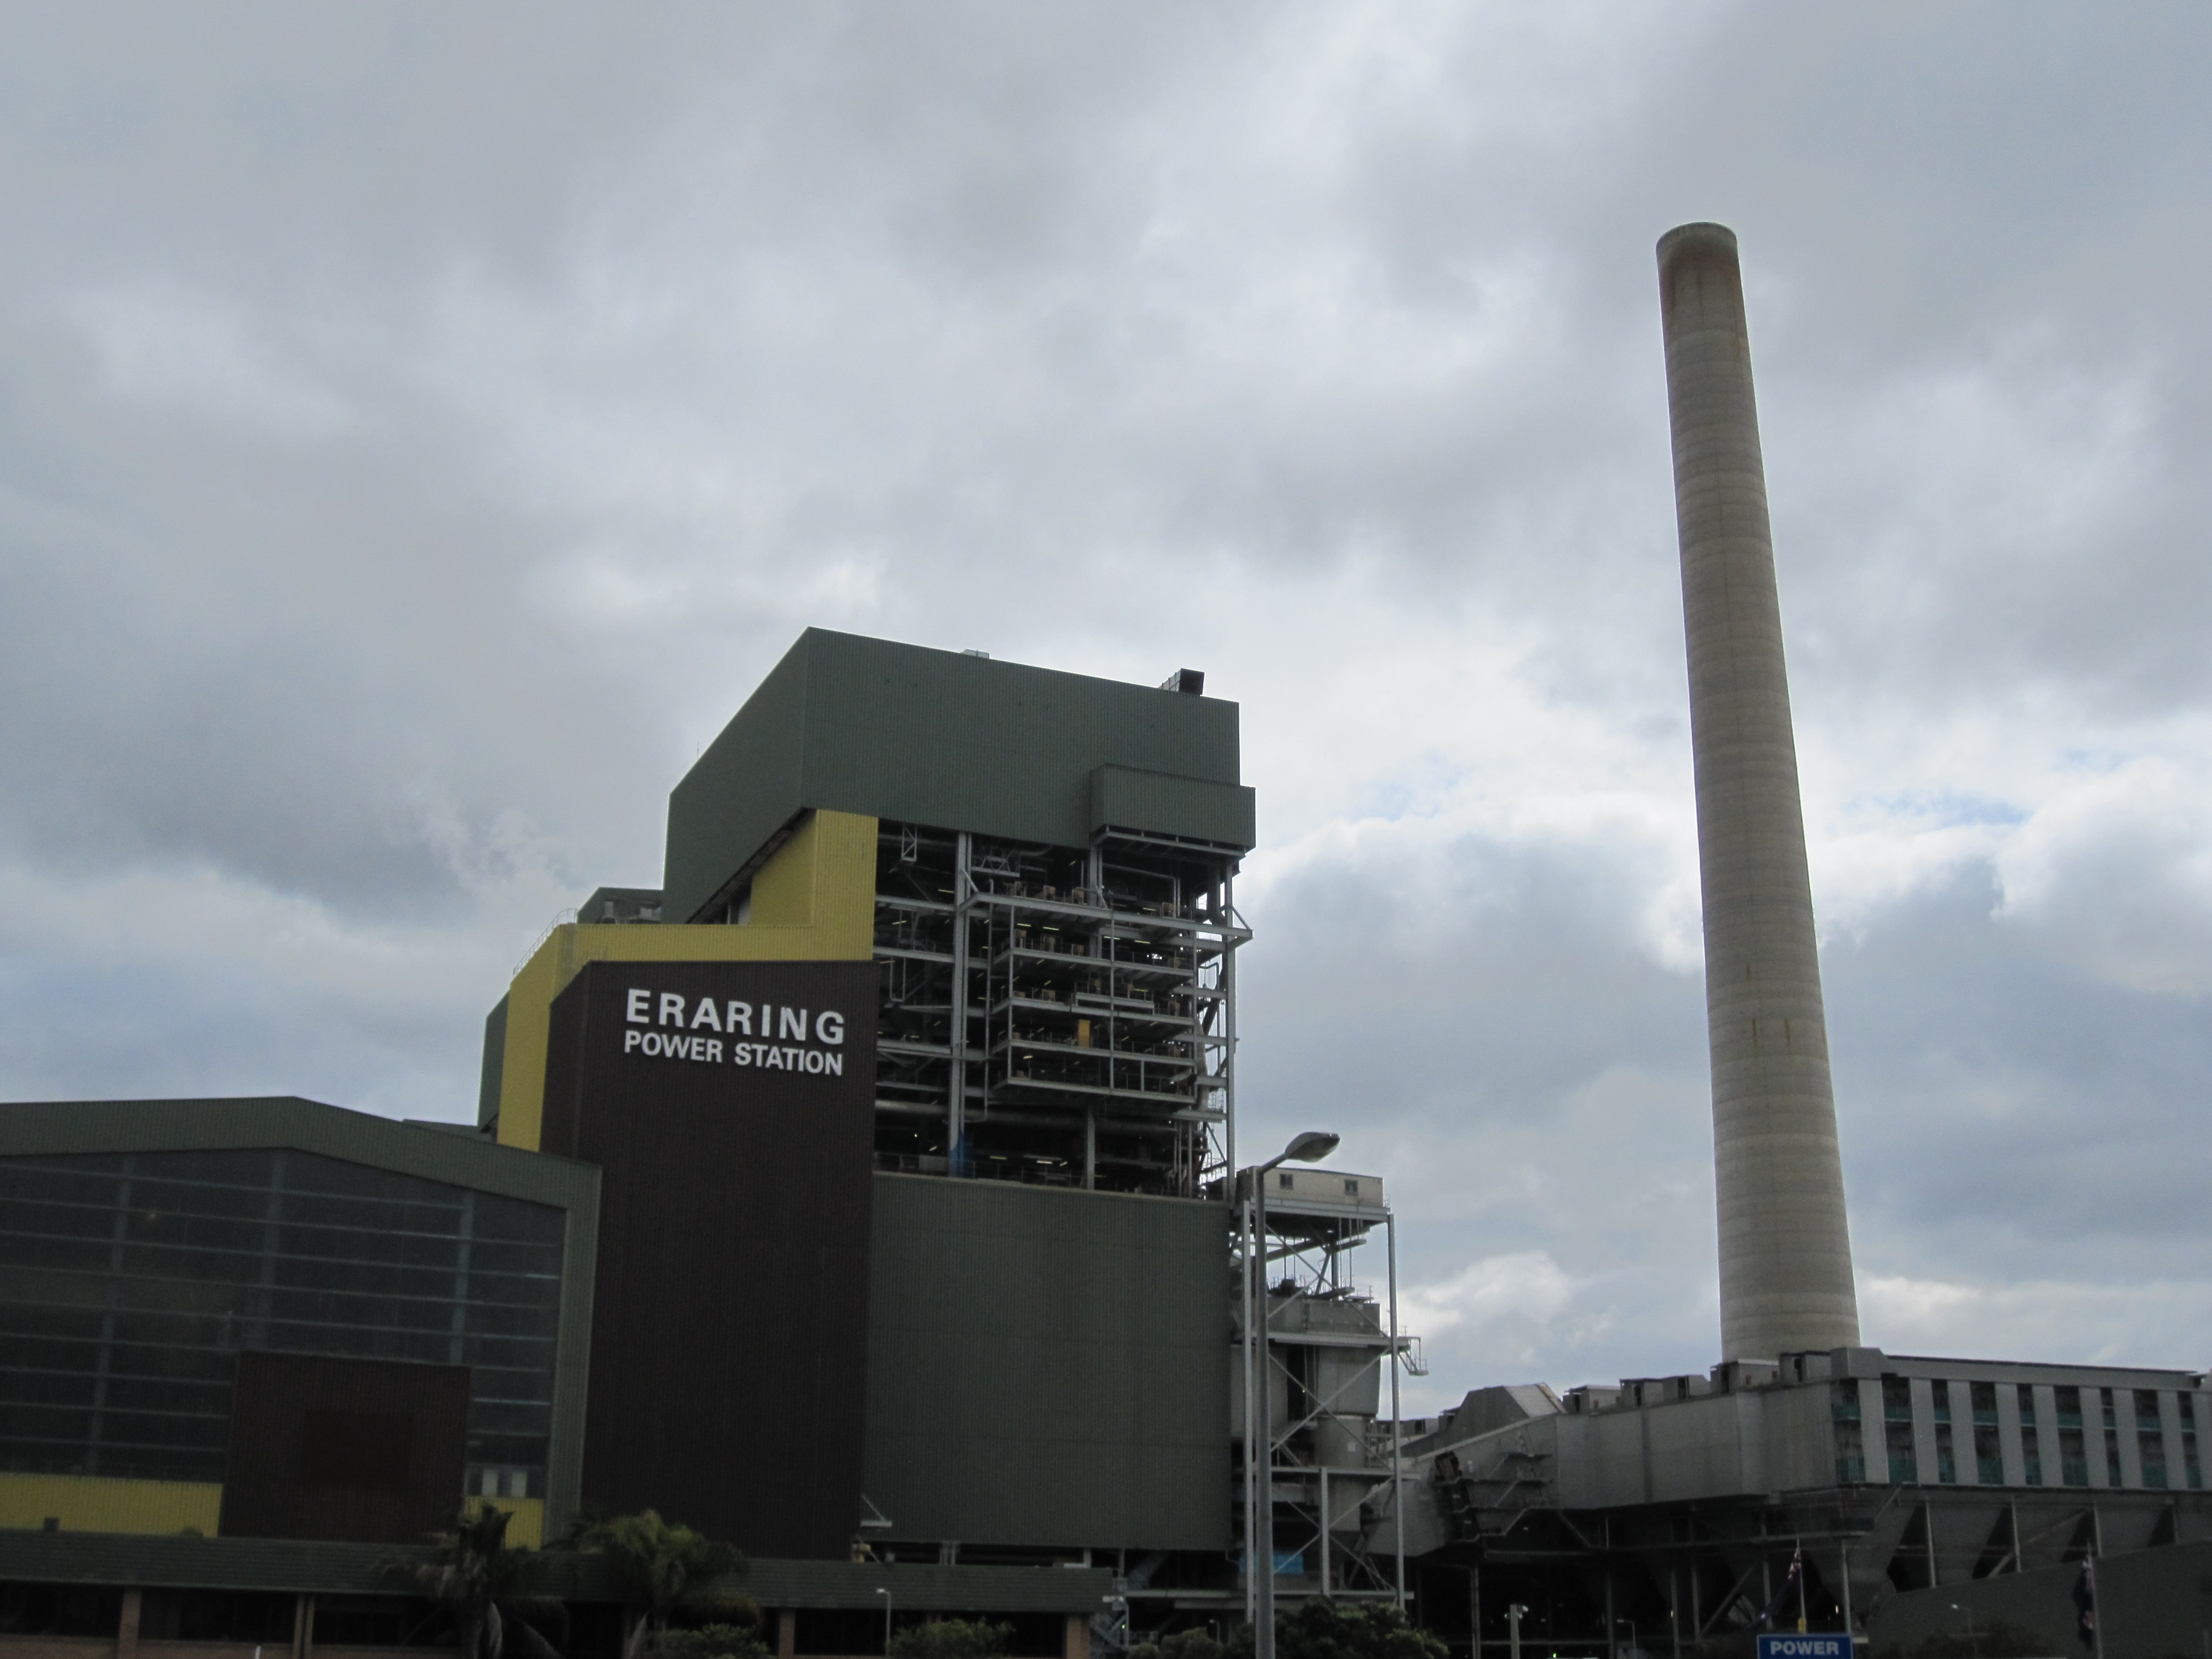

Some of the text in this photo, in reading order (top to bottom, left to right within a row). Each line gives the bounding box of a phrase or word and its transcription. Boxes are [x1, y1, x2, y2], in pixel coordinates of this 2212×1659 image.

[626, 988, 844, 1045] ERARING
[624, 1030, 843, 1077] POWER STATION
[1770, 1641, 1840, 1656] POWER
